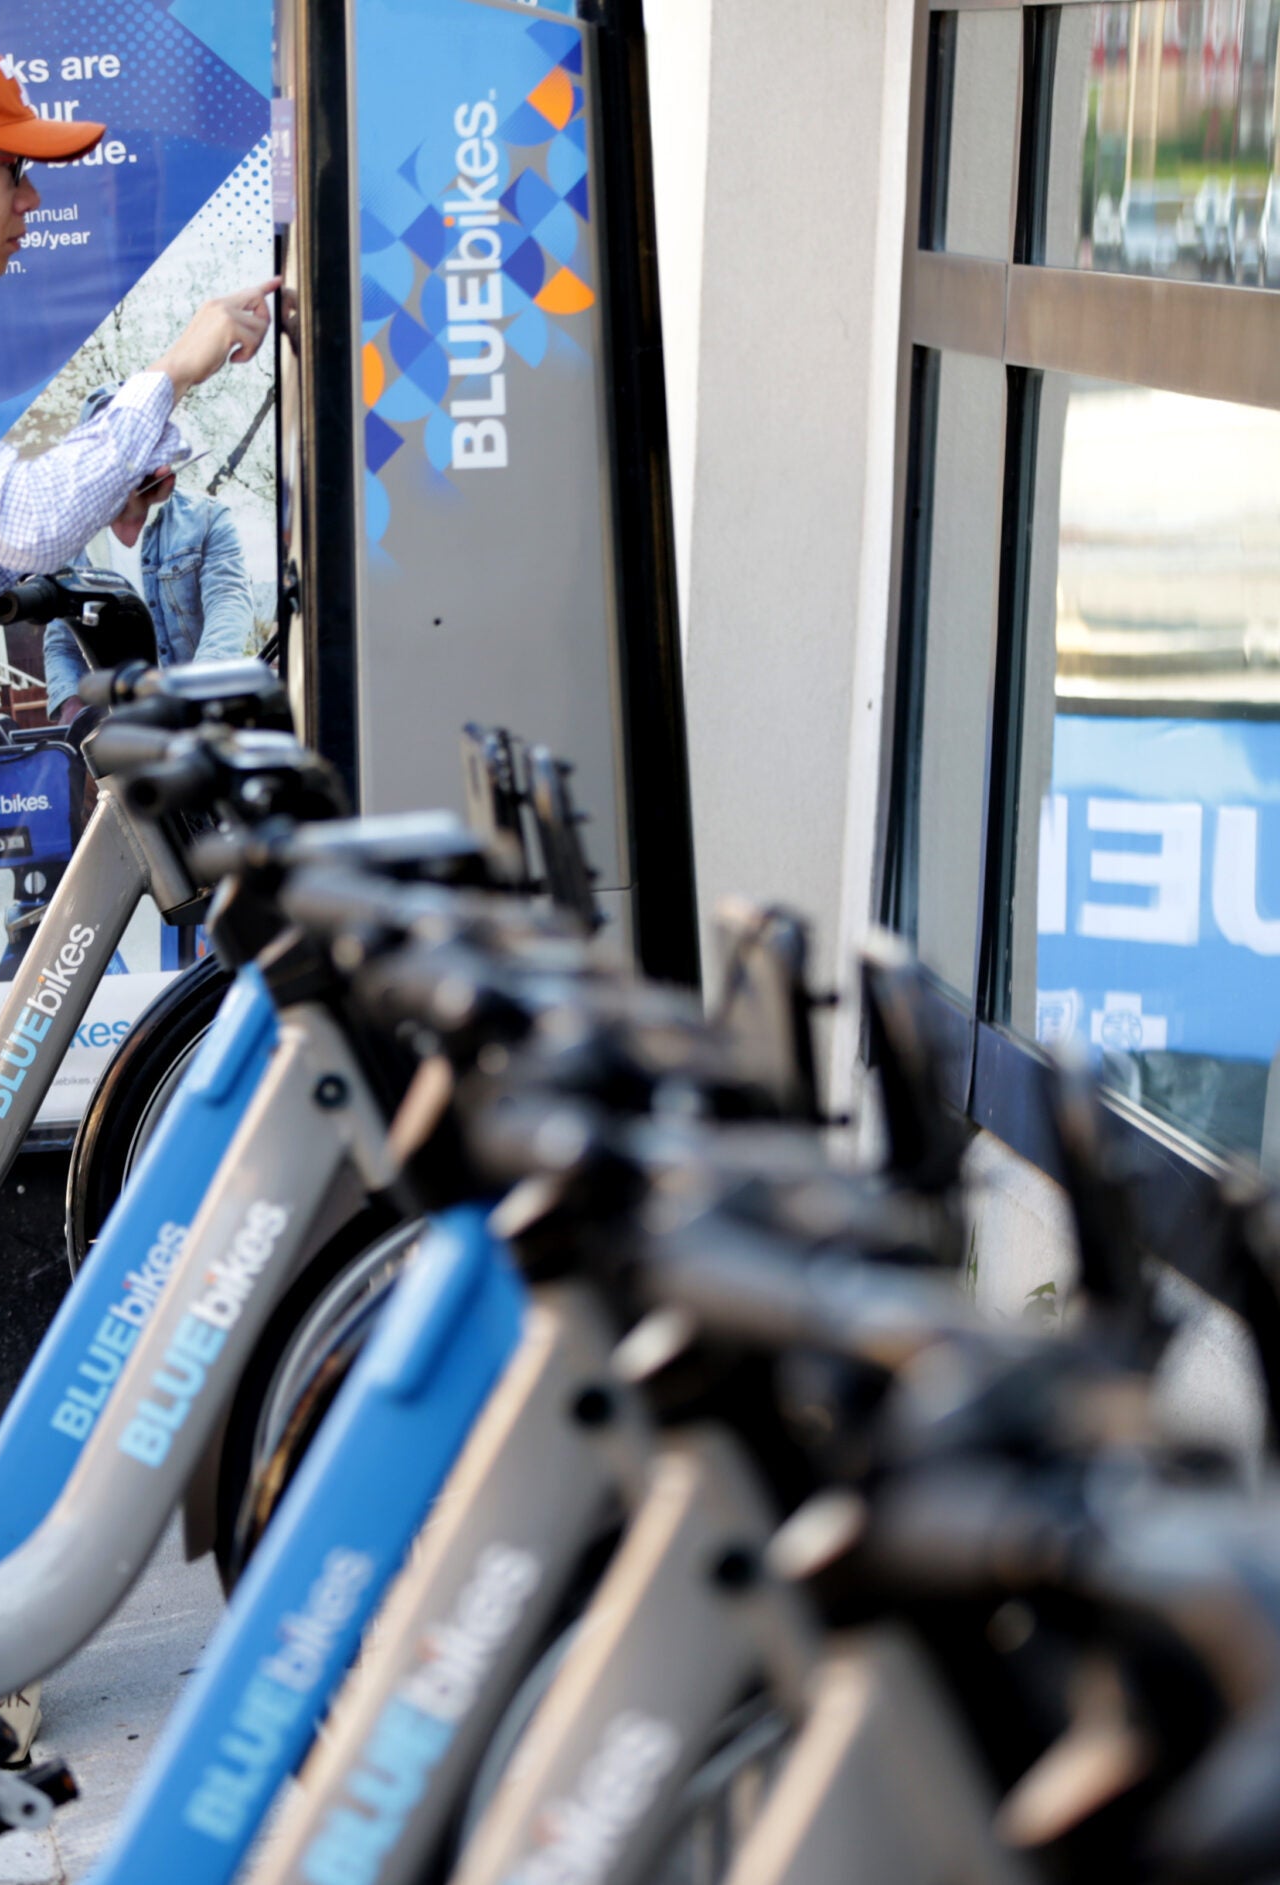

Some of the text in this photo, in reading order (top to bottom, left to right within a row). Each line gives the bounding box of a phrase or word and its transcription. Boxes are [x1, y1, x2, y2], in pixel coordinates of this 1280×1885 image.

[4, 53, 121, 83] ks are
[443, 101, 508, 470] BLUEbikes
[51, 1221, 189, 1442] BLUEbikes
[120, 1200, 289, 1468] BLUEbikes
[184, 1546, 375, 1841] BLUEbikes
